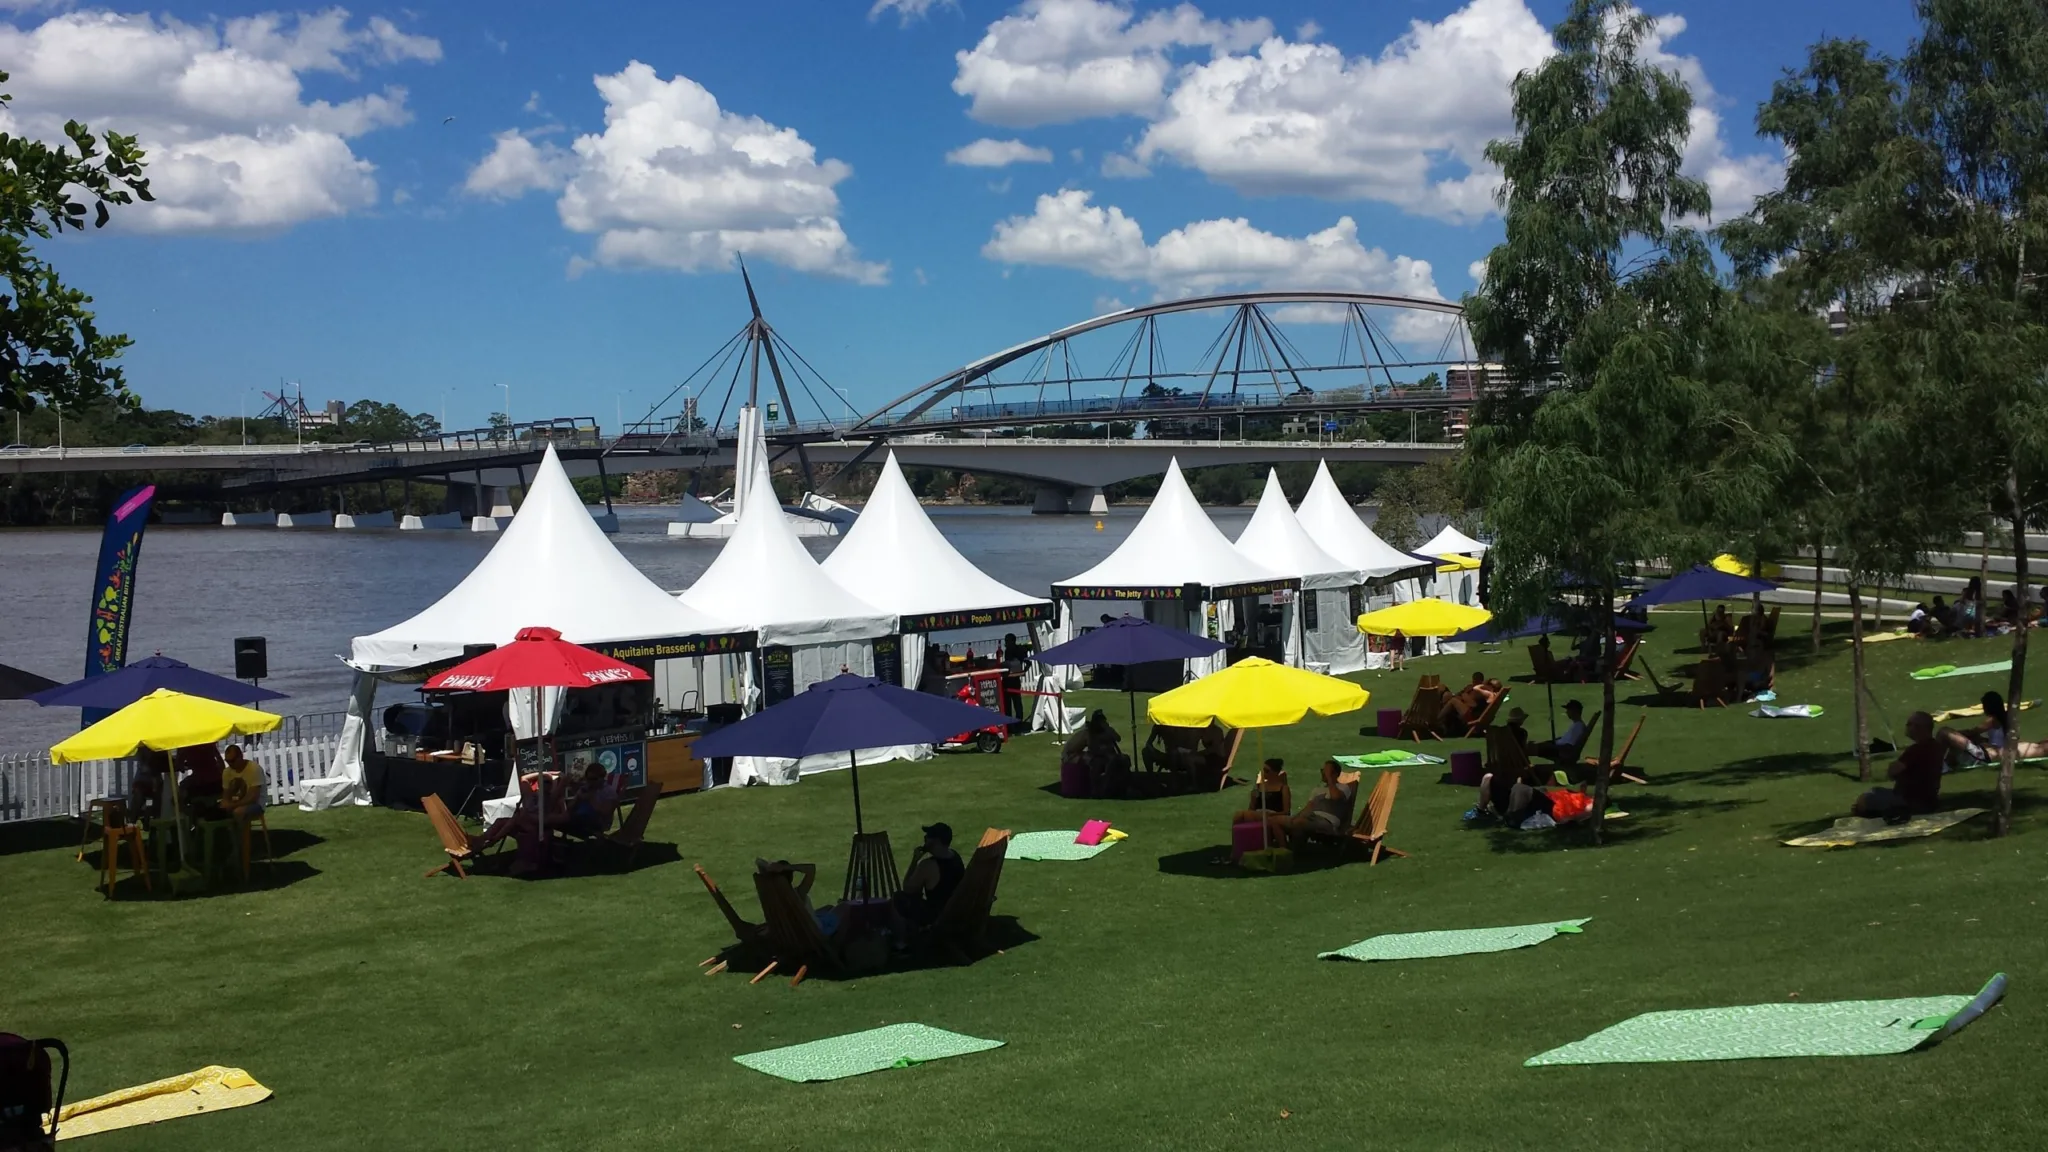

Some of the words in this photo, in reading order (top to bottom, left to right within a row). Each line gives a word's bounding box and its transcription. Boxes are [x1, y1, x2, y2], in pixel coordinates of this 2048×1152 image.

[123, 575, 131, 595] BITES
[1114, 589, 1127, 598] The
[1127, 589, 1142, 600] Jetty
[117, 595, 129, 639] AUSTRALIAN
[971, 612, 992, 625] Popolo
[114, 638, 123, 661] GREAT
[613, 644, 655, 660] Aquitaine
[656, 642, 696, 655] Brasserie
